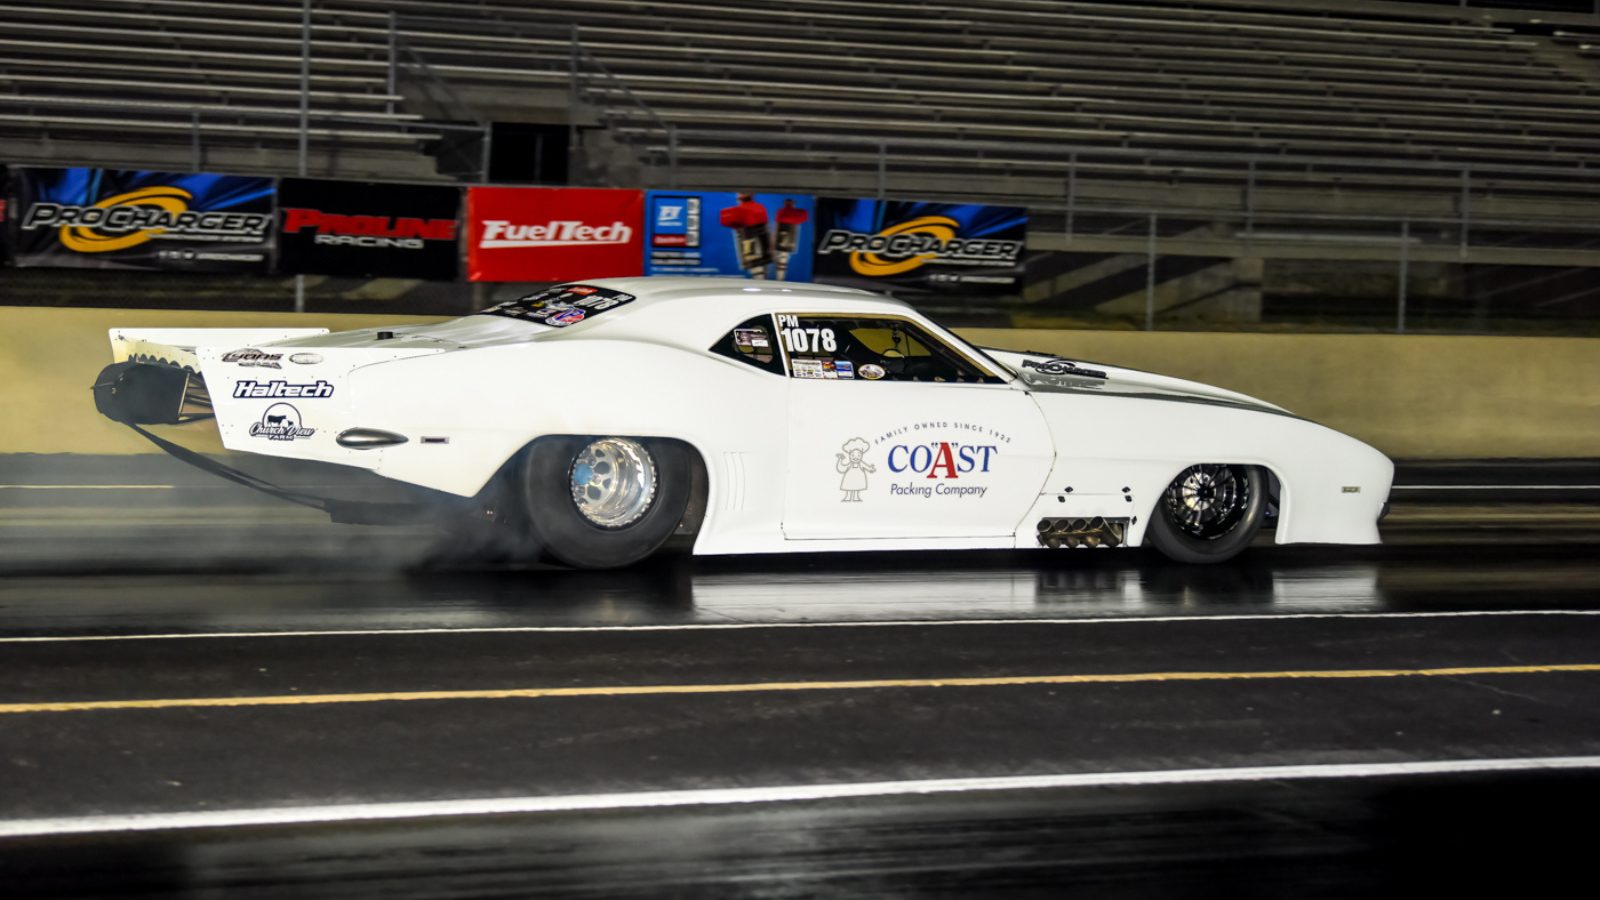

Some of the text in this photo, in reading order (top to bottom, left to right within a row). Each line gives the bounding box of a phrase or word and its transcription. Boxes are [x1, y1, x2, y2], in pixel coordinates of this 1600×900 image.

[283, 208, 458, 241] PROLINE
[480, 220, 633, 247] FuelTech
[314, 234, 424, 249] RACING
[778, 314, 799, 328] PM
[781, 328, 837, 353] 1078
[232, 380, 335, 399] Haltech
[874, 421, 1011, 445] FAMILY OWNED SINCE 1922
[890, 482, 988, 498] Packing Company
